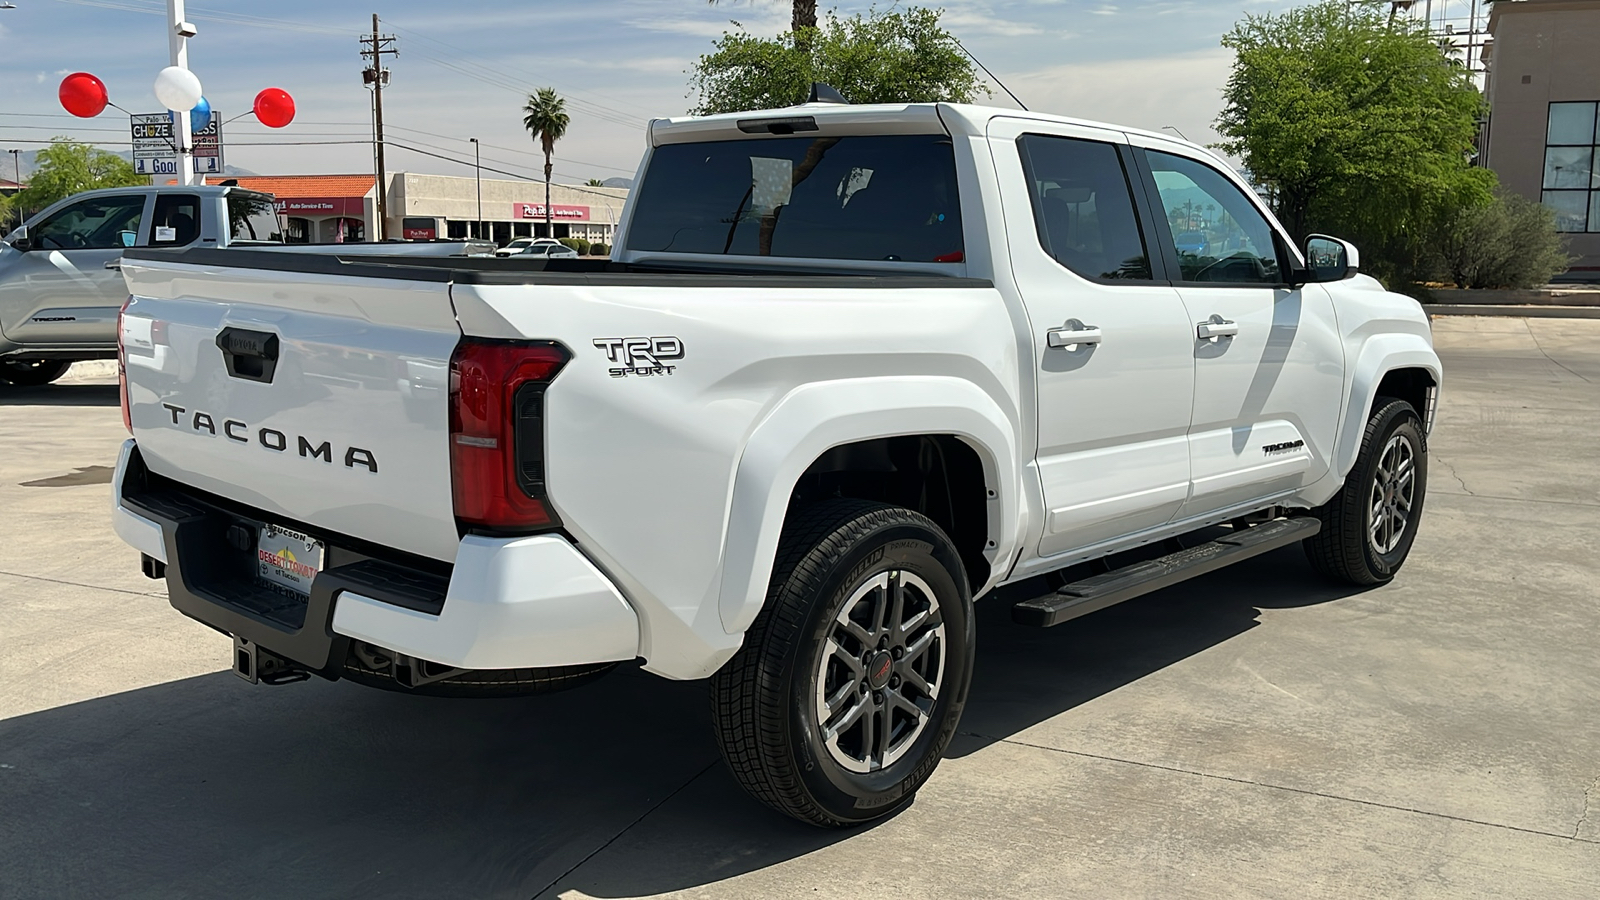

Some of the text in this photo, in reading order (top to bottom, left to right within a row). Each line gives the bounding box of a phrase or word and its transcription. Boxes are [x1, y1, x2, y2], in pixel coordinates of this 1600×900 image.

[523, 204, 538, 216] Pep
[537, 205, 554, 217] Bos
[230, 337, 258, 351] TOYOTA
[593, 336, 685, 367] TRD
[608, 366, 676, 378] SPORT
[163, 403, 378, 473] TACOMA
[1262, 439, 1304, 453] TACOMA
[259, 550, 286, 569] DESERT
[281, 571, 300, 583] Tucson
[833, 541, 919, 606] MICHELIN PRIMACY
[902, 732, 948, 793] MICHELIN
